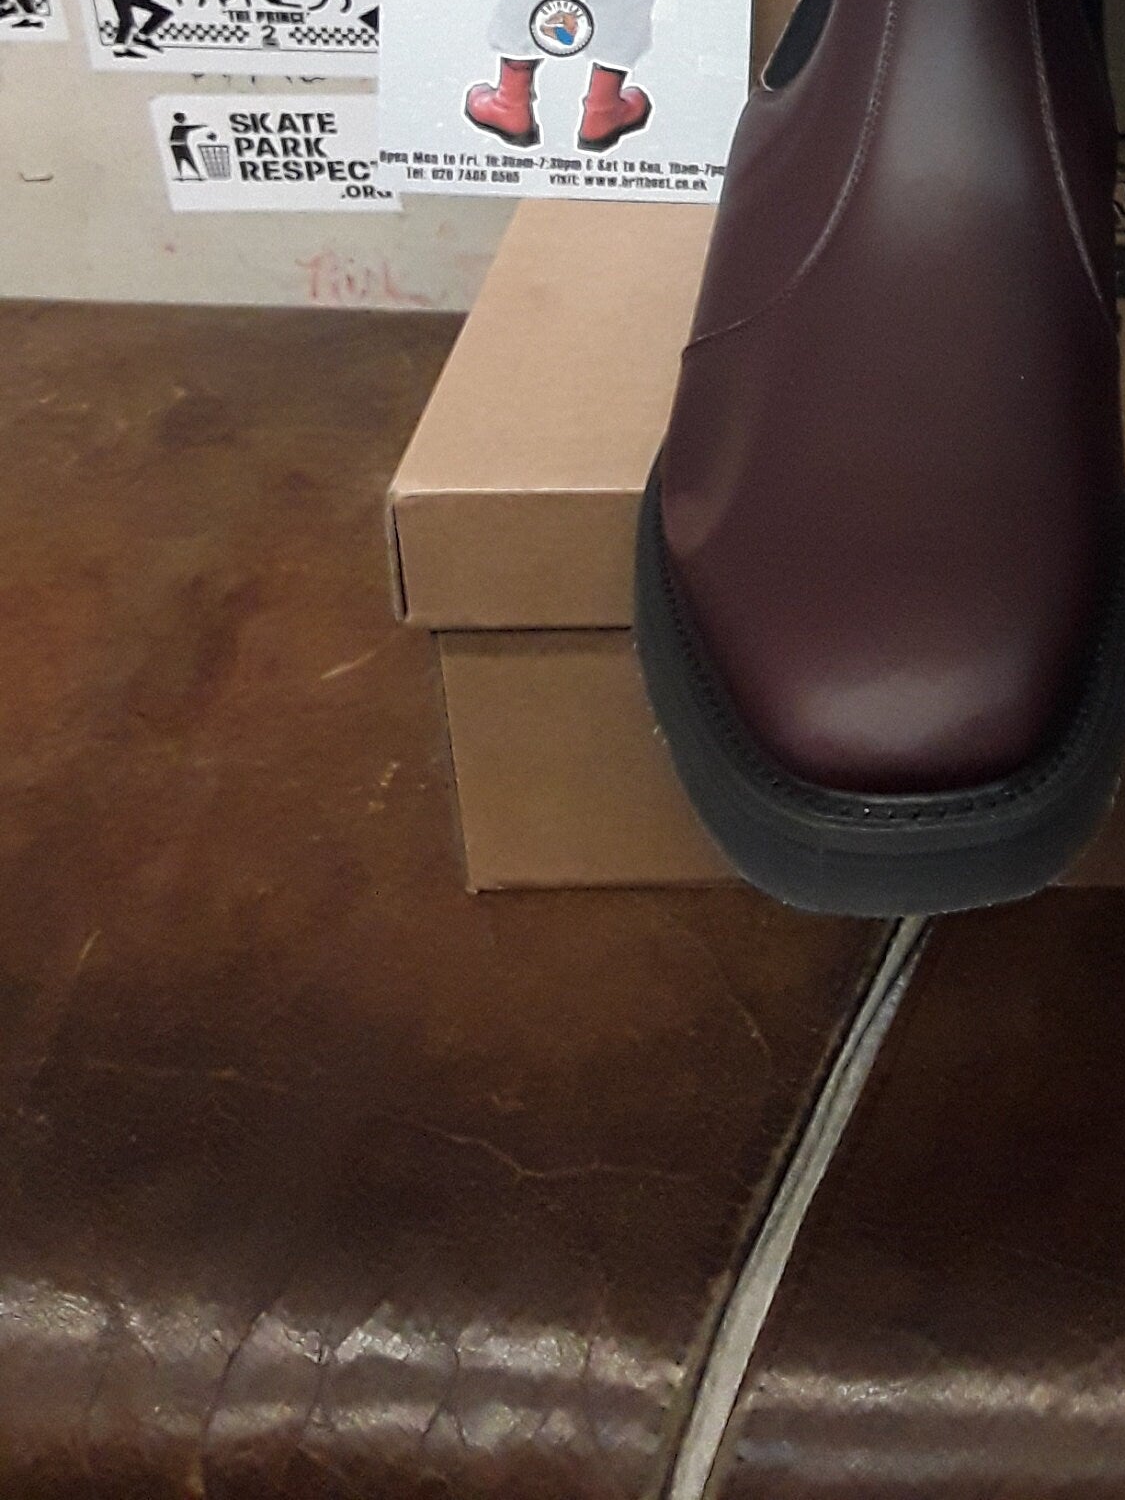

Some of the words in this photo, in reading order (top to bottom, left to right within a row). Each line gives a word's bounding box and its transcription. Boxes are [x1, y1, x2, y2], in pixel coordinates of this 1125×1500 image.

[229, 113, 337, 134] SKATE
[234, 137, 326, 158] PARK
[240, 160, 378, 182] RESPEC
